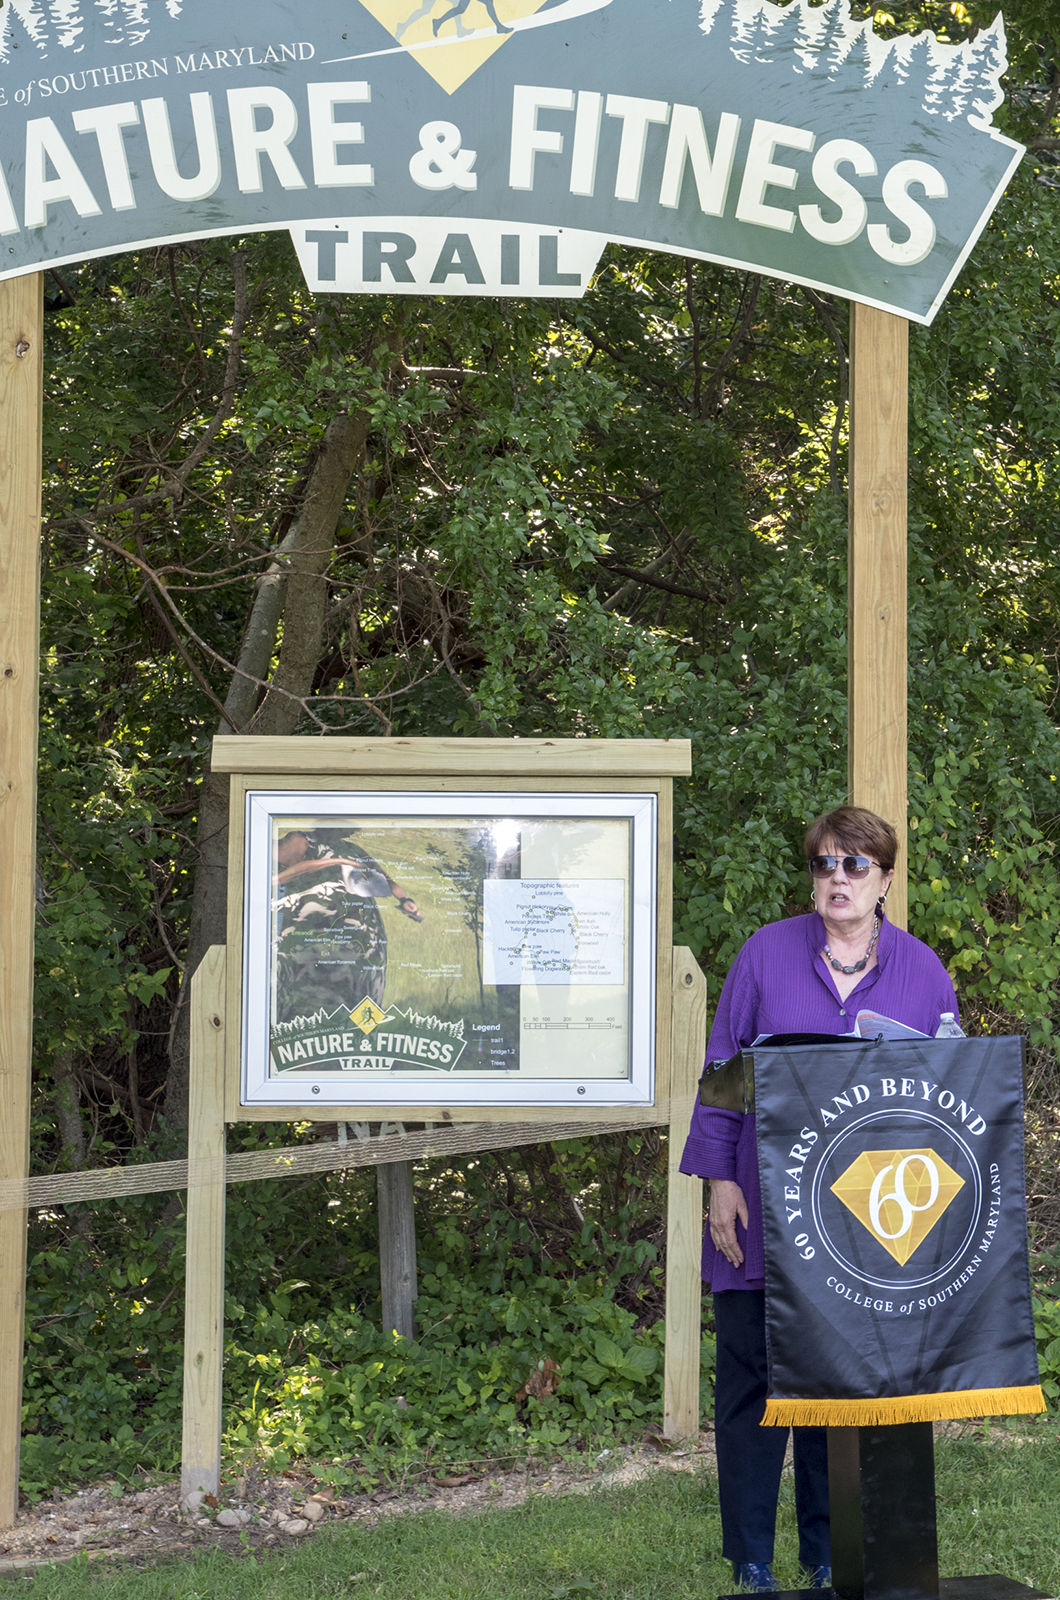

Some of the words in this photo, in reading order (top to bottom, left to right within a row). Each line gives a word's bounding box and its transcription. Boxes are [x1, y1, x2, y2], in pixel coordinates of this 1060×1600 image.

[14, 79, 36, 107] of
[38, 57, 169, 97] SOUTHERN
[175, 41, 316, 74] MARYLAND
[0, 81, 375, 236] ATURE
[408, 120, 478, 192] &
[508, 84, 949, 267] FITNESS
[304, 230, 582, 286] TRAIL
[520, 882, 555, 890] Topographic
[277, 1032, 354, 1065] NATURE
[359, 1038, 372, 1052] &
[376, 1032, 454, 1063] FITNESS
[472, 1023, 501, 1032] Legend
[342, 1058, 390, 1068] TRAIL
[819, 1084, 871, 1128] AND
[880, 1077, 988, 1136] BEYOND
[784, 1126, 819, 1224] YEARS
[868, 1154, 940, 1239] 60
[794, 1232, 816, 1261] 60
[826, 1276, 894, 1313] COLLEGE
[899, 1301, 915, 1315] of
[919, 1254, 983, 1311] SOUTHERN
[979, 1162, 1001, 1253] MARYLAND
